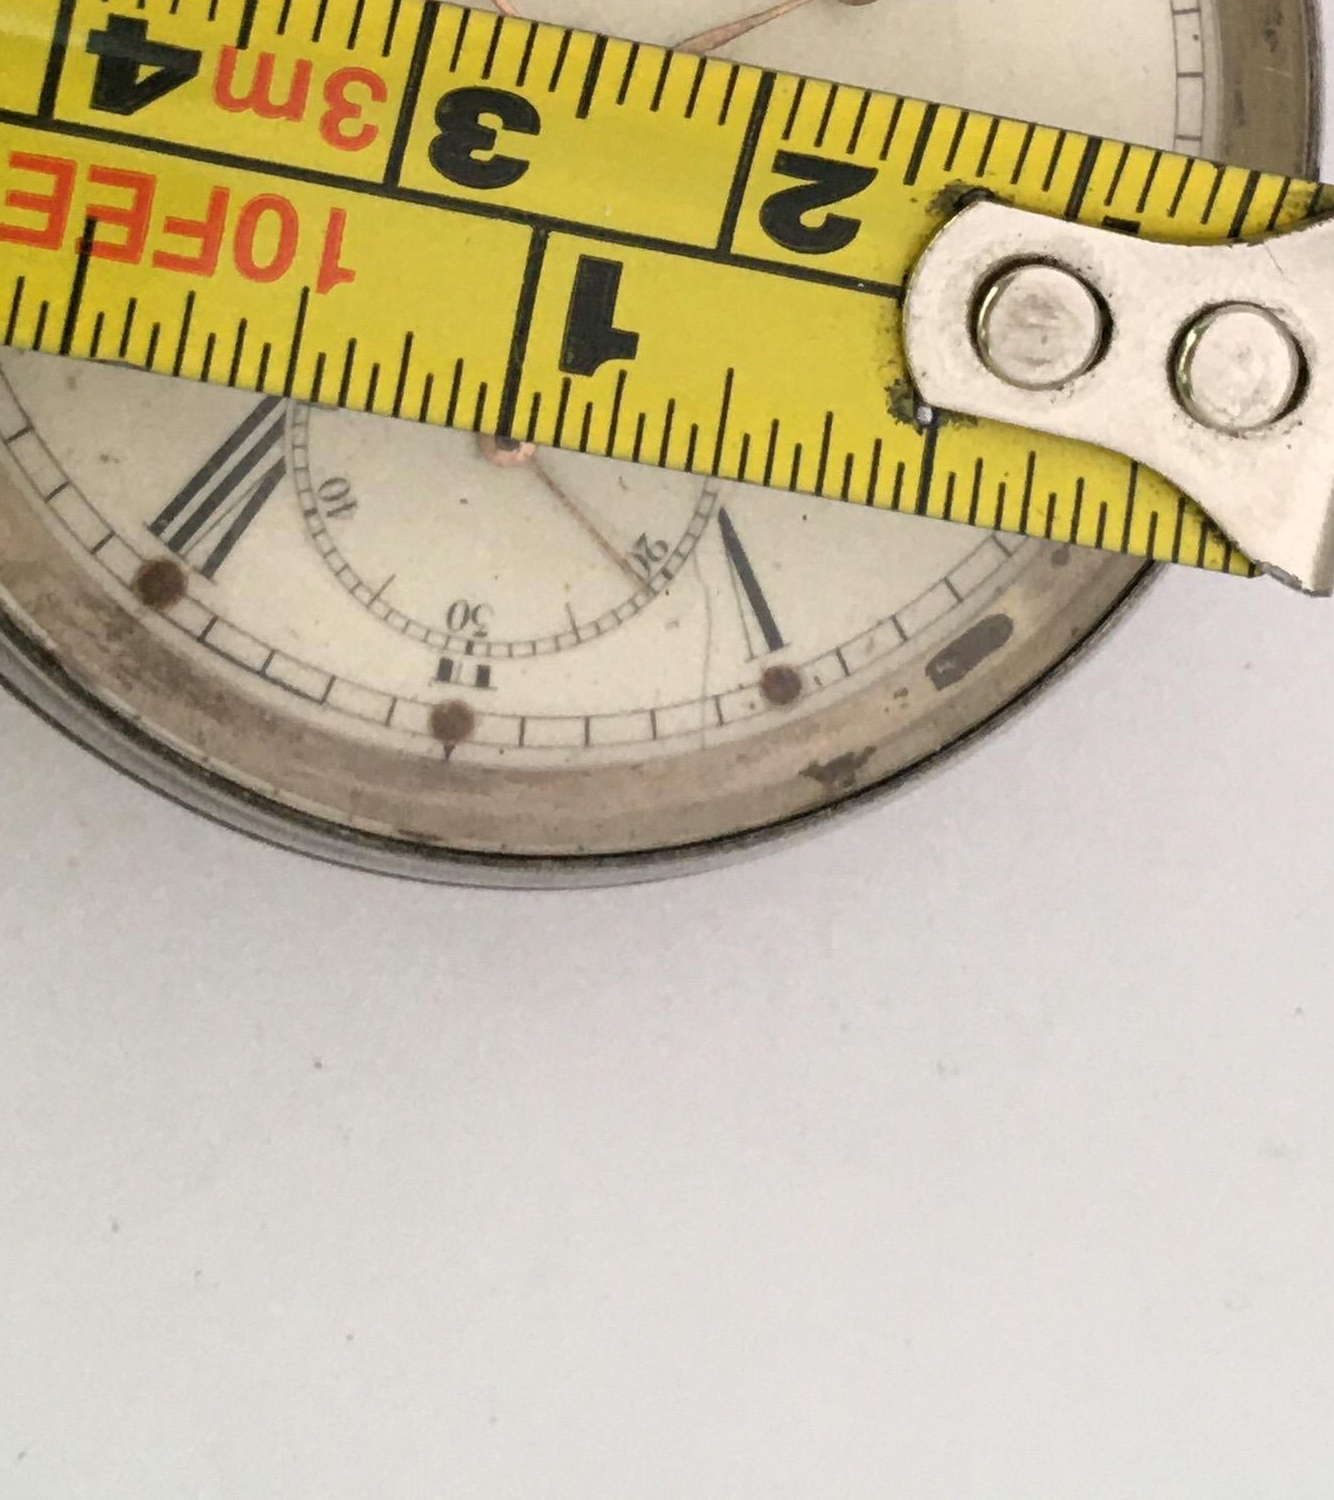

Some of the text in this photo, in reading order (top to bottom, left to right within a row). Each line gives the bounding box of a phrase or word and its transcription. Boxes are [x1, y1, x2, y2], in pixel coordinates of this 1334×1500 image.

[85, 13, 202, 116] 4
[427, 85, 541, 190] 3
[758, 149, 878, 254] 2
[557, 254, 639, 377] 1
